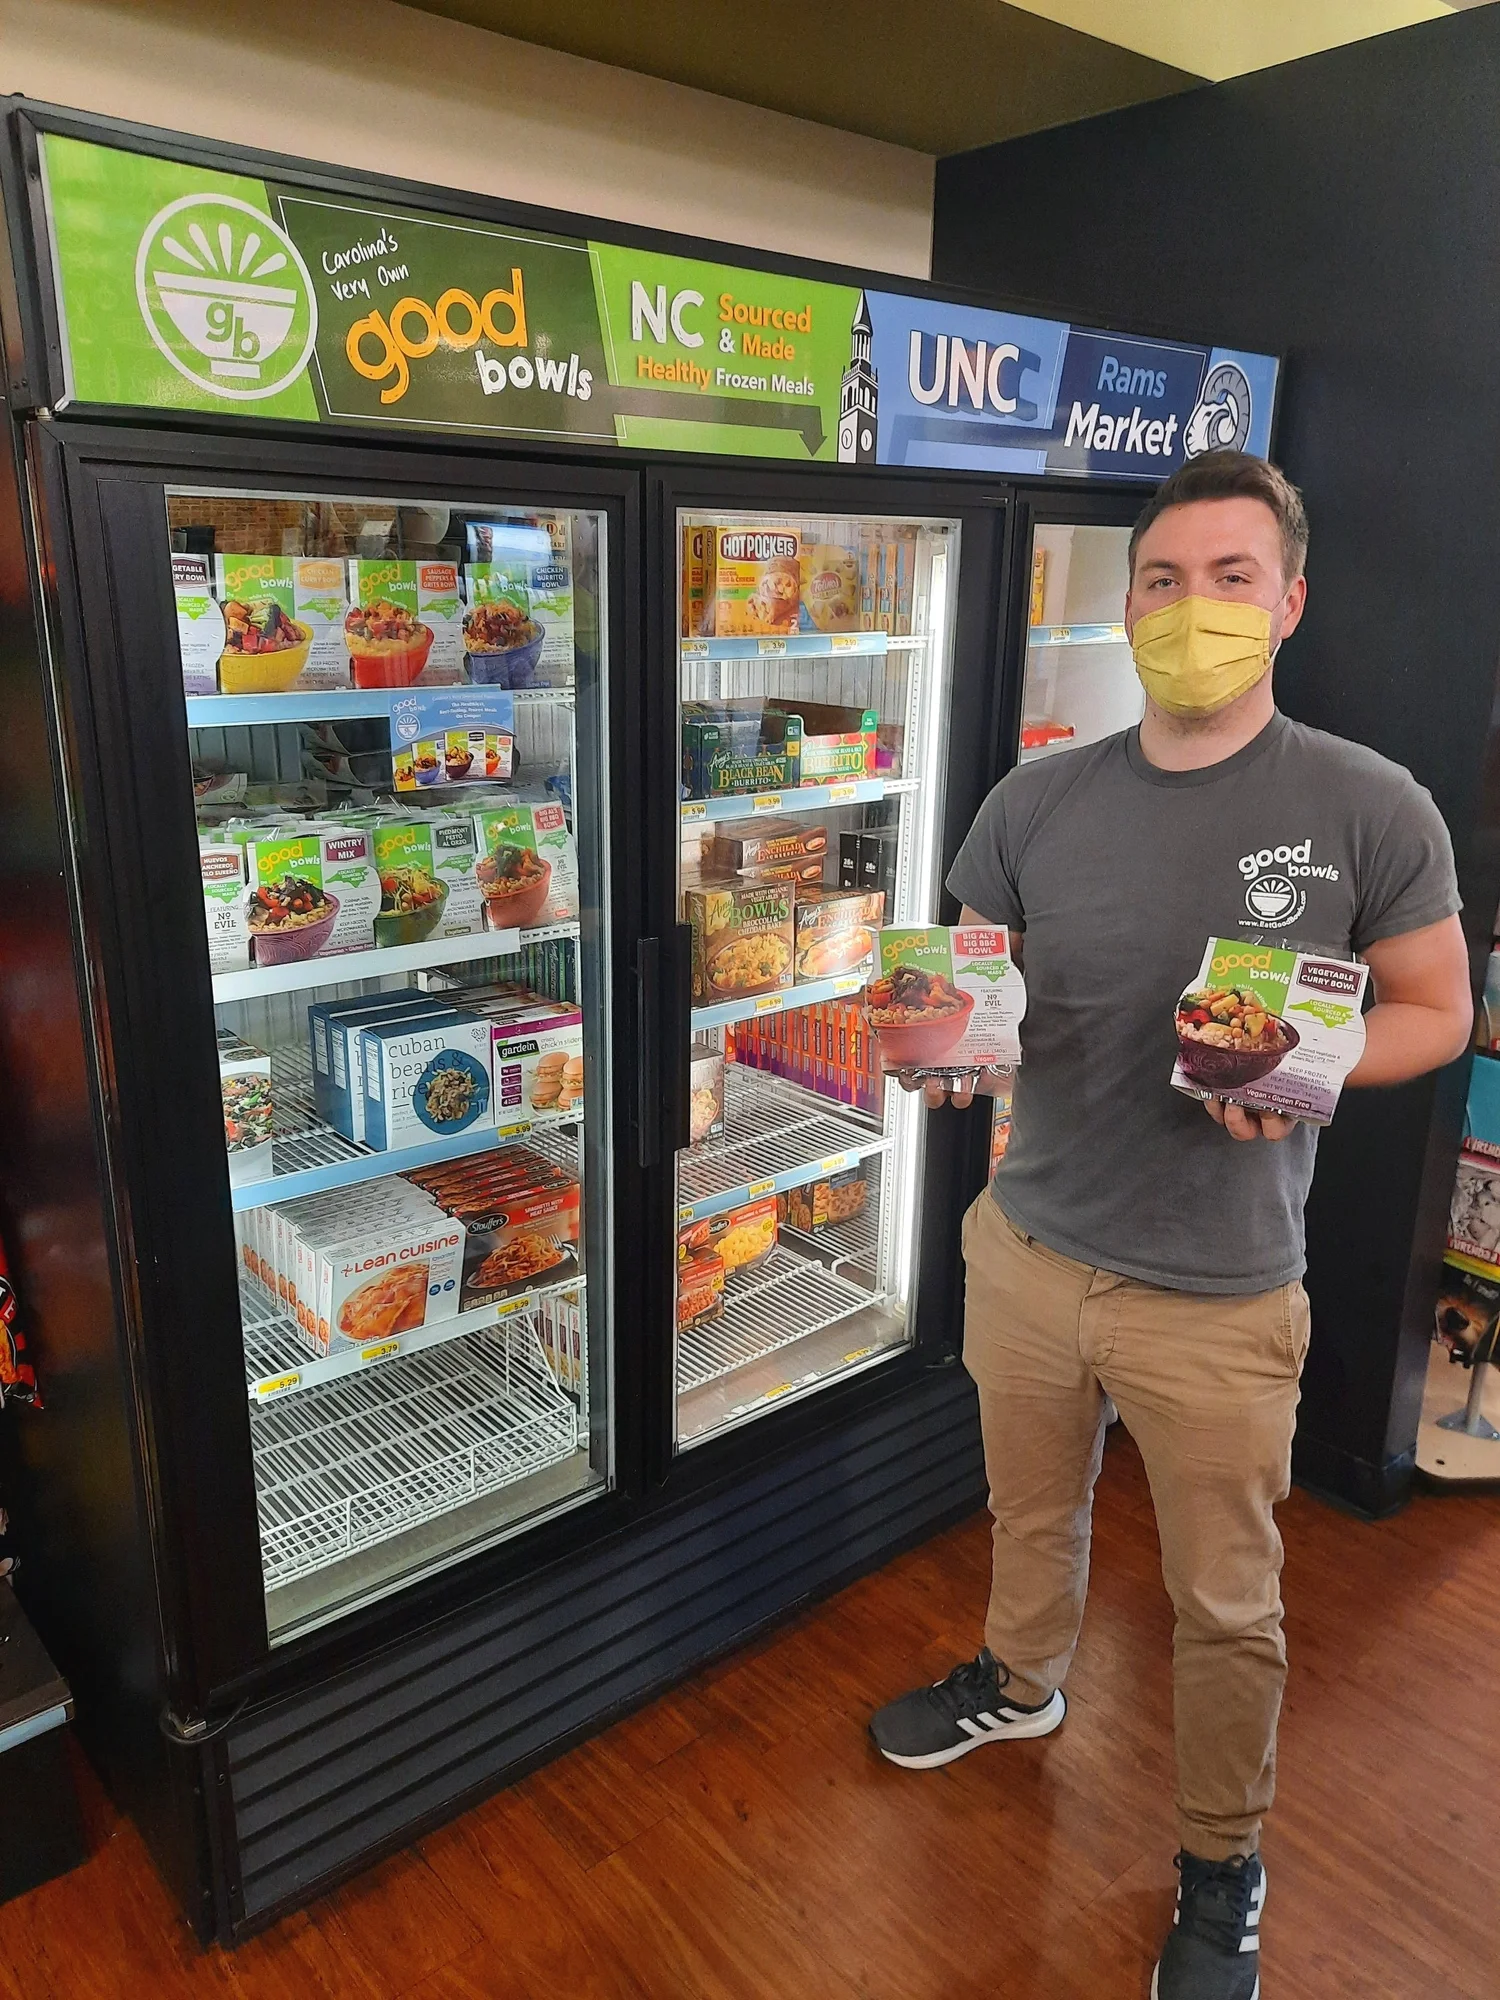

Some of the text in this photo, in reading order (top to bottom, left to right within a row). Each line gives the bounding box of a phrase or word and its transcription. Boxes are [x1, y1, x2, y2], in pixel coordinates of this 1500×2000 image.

[322, 229, 400, 277] Carolina's
[377, 262, 410, 286] Own
[630, 280, 705, 348] NC
[718, 293, 813, 334] Sourced
[205, 300, 261, 360] gb
[345, 268, 530, 404] good
[718, 328, 796, 361] & Made
[476, 349, 594, 402] bowls
[637, 355, 815, 397] Healthy Frozen Meals
[908, 330, 1020, 414] UNC
[1096, 355, 1168, 398] Rams
[1064, 401, 1179, 457] Market
[723, 534, 794, 559] HOT POCKETS
[172, 564, 204, 573] GETABLE
[226, 558, 275, 592] good
[259, 577, 294, 590] bowls
[359, 564, 402, 597] good
[388, 580, 417, 593] bowls
[392, 695, 417, 715] good
[710, 750, 733, 773] Amy's
[803, 752, 862, 775] BURRITO
[719, 765, 787, 788] BLACK BEAN
[328, 838, 363, 851] WINTRY
[337, 849, 355, 860] MIX
[376, 828, 416, 861] good
[403, 842, 433, 855] bowls
[756, 841, 807, 863] ENCHILADA
[201, 863, 234, 871] ANCHEROS
[258, 842, 304, 875] good
[289, 855, 321, 869] bowls
[1238, 839, 1312, 880] good
[1287, 862, 1340, 882] bowls
[729, 897, 790, 929] BOWLS
[883, 932, 929, 960] good
[963, 932, 977, 940] BIG
[963, 940, 997, 948] BIG BBQ
[914, 944, 948, 957] bowls
[968, 947, 994, 955] BOWL
[1211, 951, 1273, 978] good
[1307, 966, 1355, 983] VEGETABLE
[1249, 967, 1291, 986] bowls
[1301, 974, 1357, 993] CURRY BOWL
[388, 1037, 447, 1059] cuban
[501, 1042, 536, 1058] gardein
[390, 1051, 466, 1080] beans &
[1303, 1069, 1328, 1079] FROZEN
[391, 1081, 428, 1101] rice
[1246, 1088, 1310, 1109] Vegan Gluten Free
[516, 1125, 532, 1134] 5.99
[514, 1300, 529, 1310] 5.29
[381, 1344, 398, 1356] 3.79
[279, 1377, 298, 1390] 5.29
